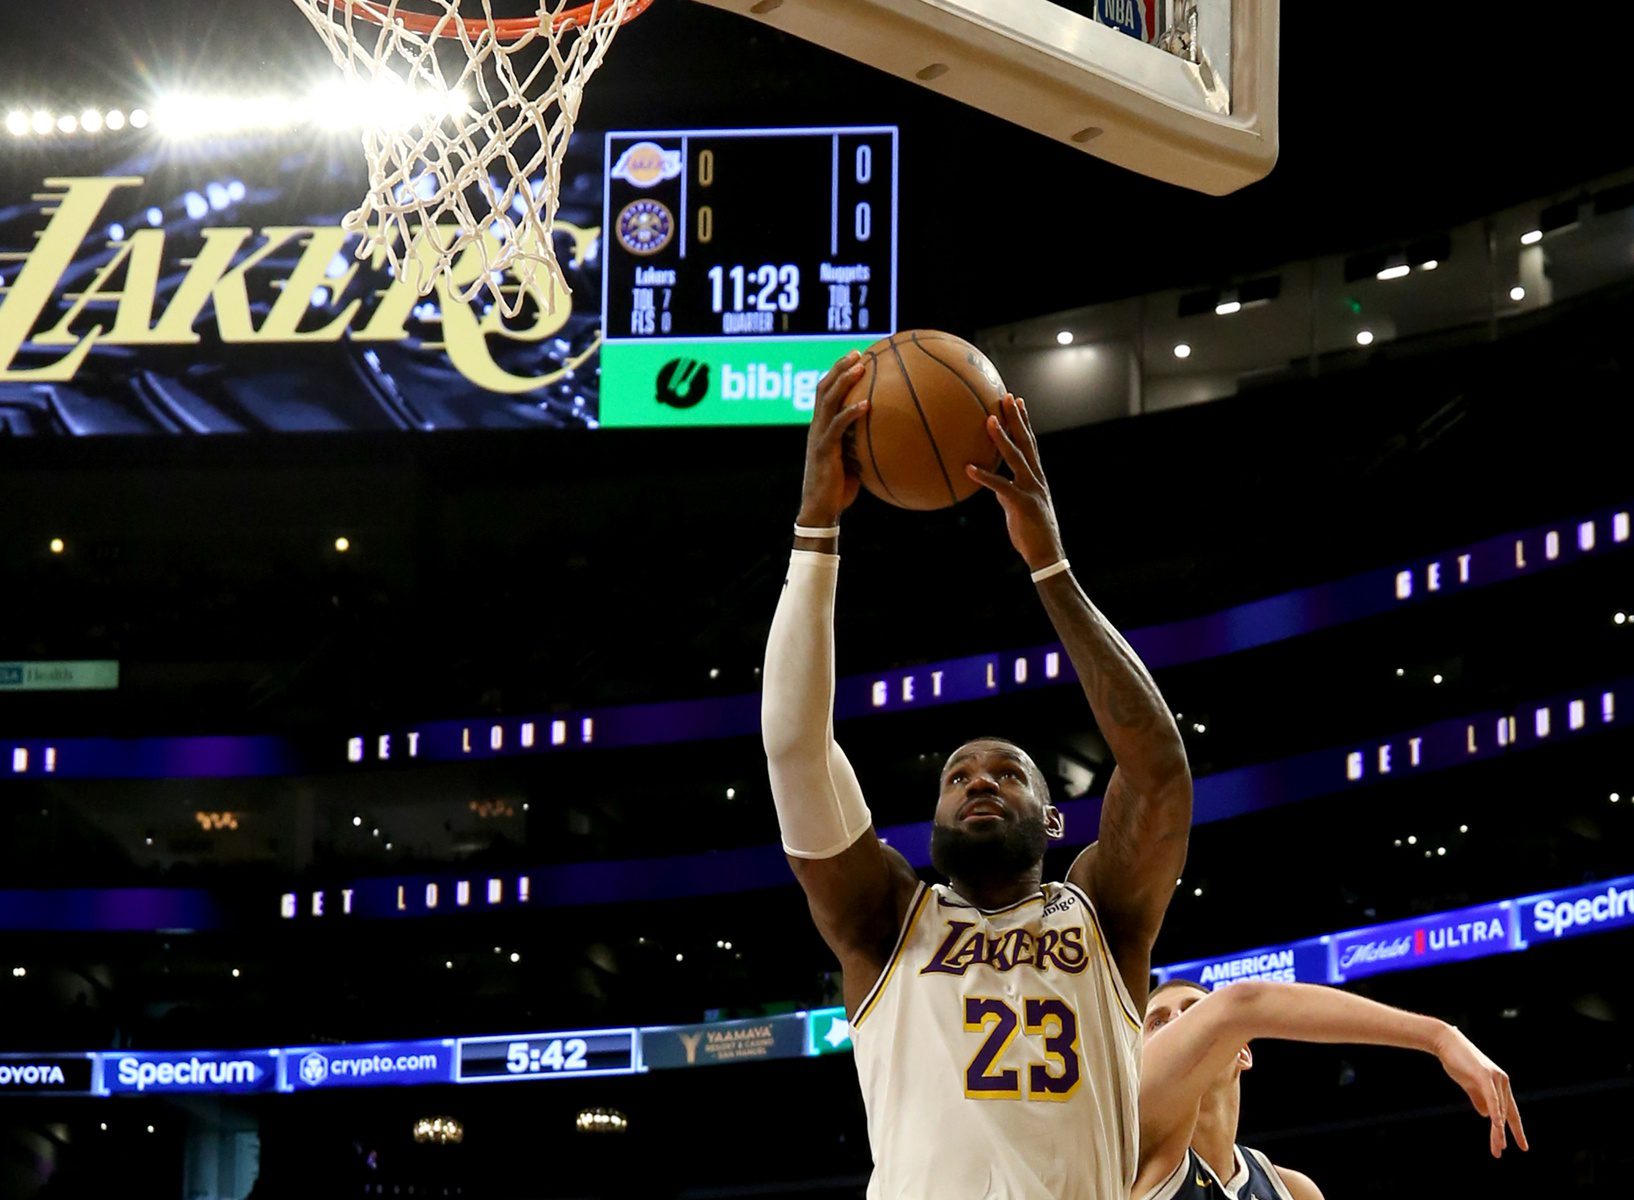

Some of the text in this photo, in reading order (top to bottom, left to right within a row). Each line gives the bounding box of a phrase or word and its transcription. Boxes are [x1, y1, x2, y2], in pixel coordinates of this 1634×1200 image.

[1104, 0, 1135, 30] NBA
[698, 149, 713, 187] 0
[856, 144, 871, 184] 0
[698, 206, 712, 243] 0
[855, 202, 871, 241] 0
[0, 176, 601, 393] LAKERS
[708, 264, 799, 313] 11:23
[721, 361, 830, 411] bibig
[1396, 554, 1470, 599] GET
[872, 671, 943, 706] GET
[348, 718, 592, 762] GET LOUD!
[1347, 737, 1422, 780] GET
[281, 876, 529, 918] GET LOUD!
[1042, 897, 1075, 918] ibigo
[918, 919, 1089, 976] LAKERS
[1429, 918, 1504, 950] ULTRA
[1200, 949, 1295, 984] AMERICAN
[330, 1054, 437, 1077] crypto.com
[506, 1039, 588, 1073] 5:42
[963, 994, 1082, 1102] 23
[0, 1065, 65, 1084] OYOTA
[118, 1057, 255, 1091] Spectrum
